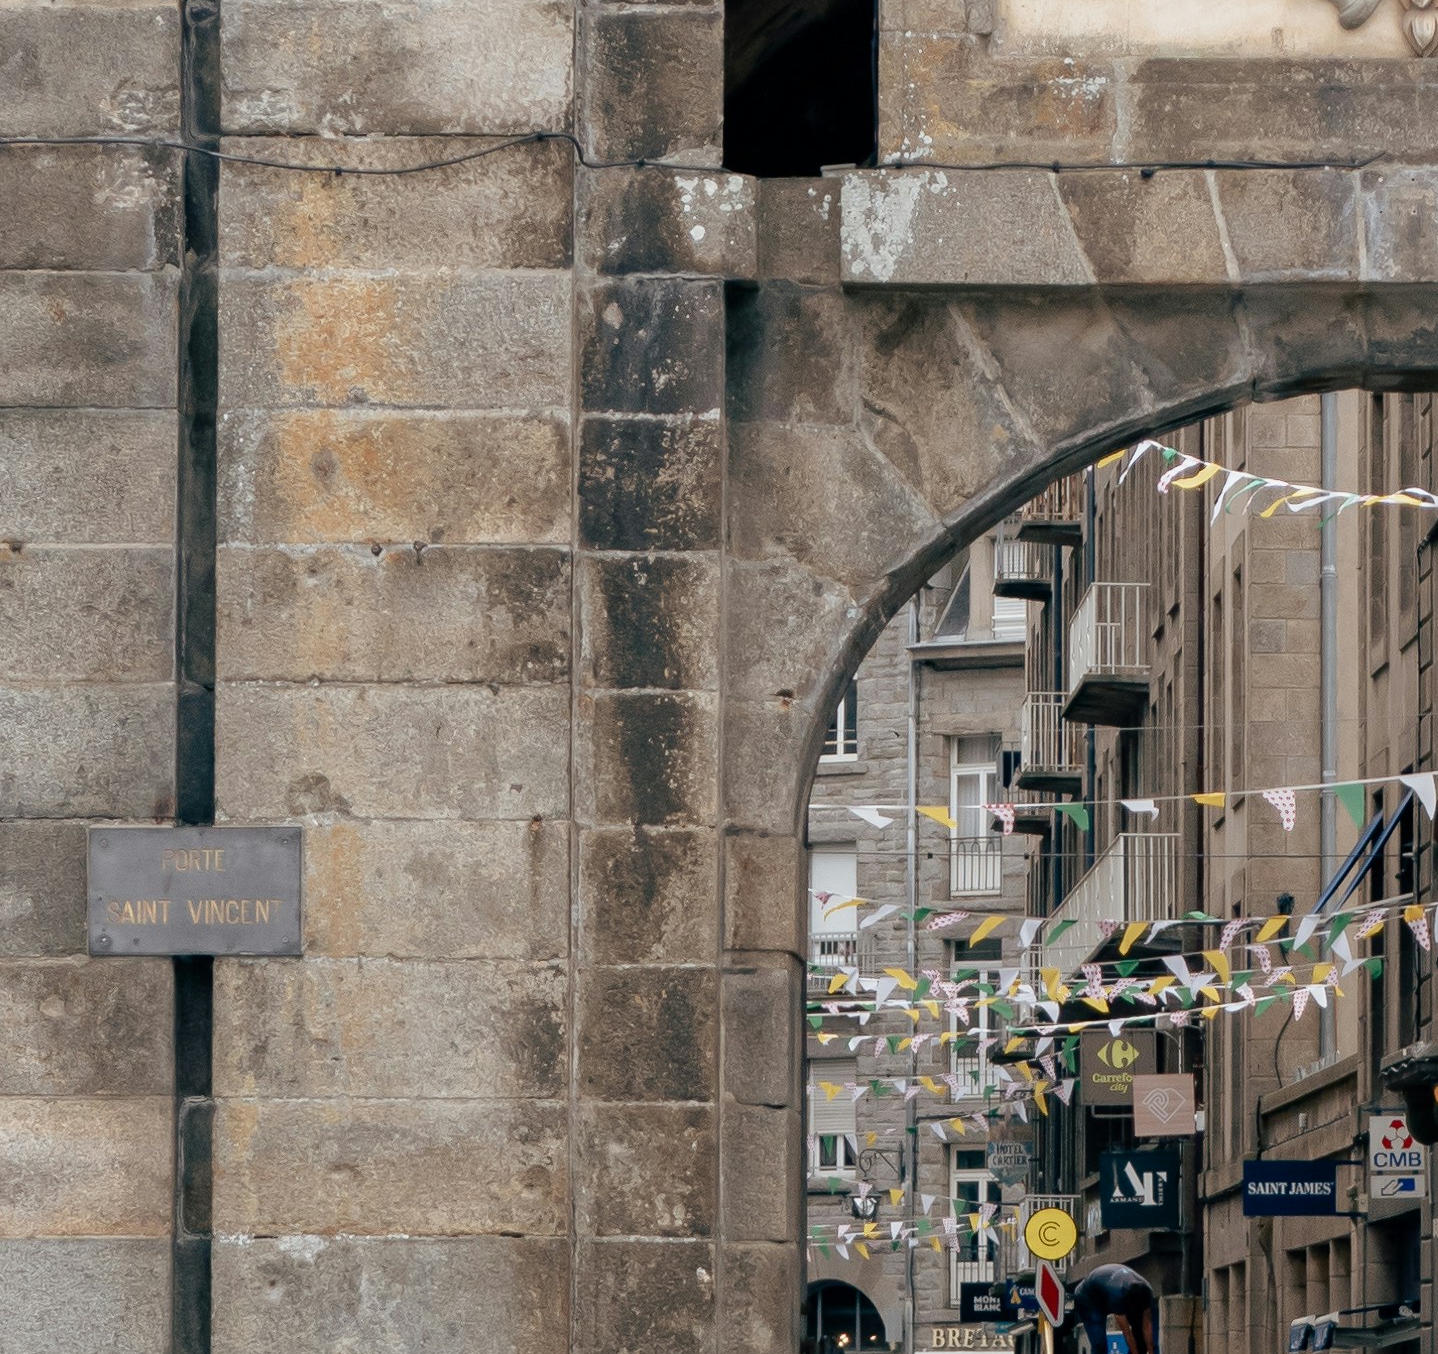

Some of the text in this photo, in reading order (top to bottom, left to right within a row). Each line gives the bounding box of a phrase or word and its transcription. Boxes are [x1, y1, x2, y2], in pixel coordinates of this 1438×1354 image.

[161, 848, 225, 872] PORTE
[106, 898, 283, 925] SAINT VINCENT
[1092, 1073, 1133, 1083] Carrefo
[1109, 1082, 1128, 1094] city
[992, 1155, 1027, 1165] CARTIER
[1373, 1151, 1422, 1168] CMB
[1247, 1181, 1332, 1195] SAINT JAMES
